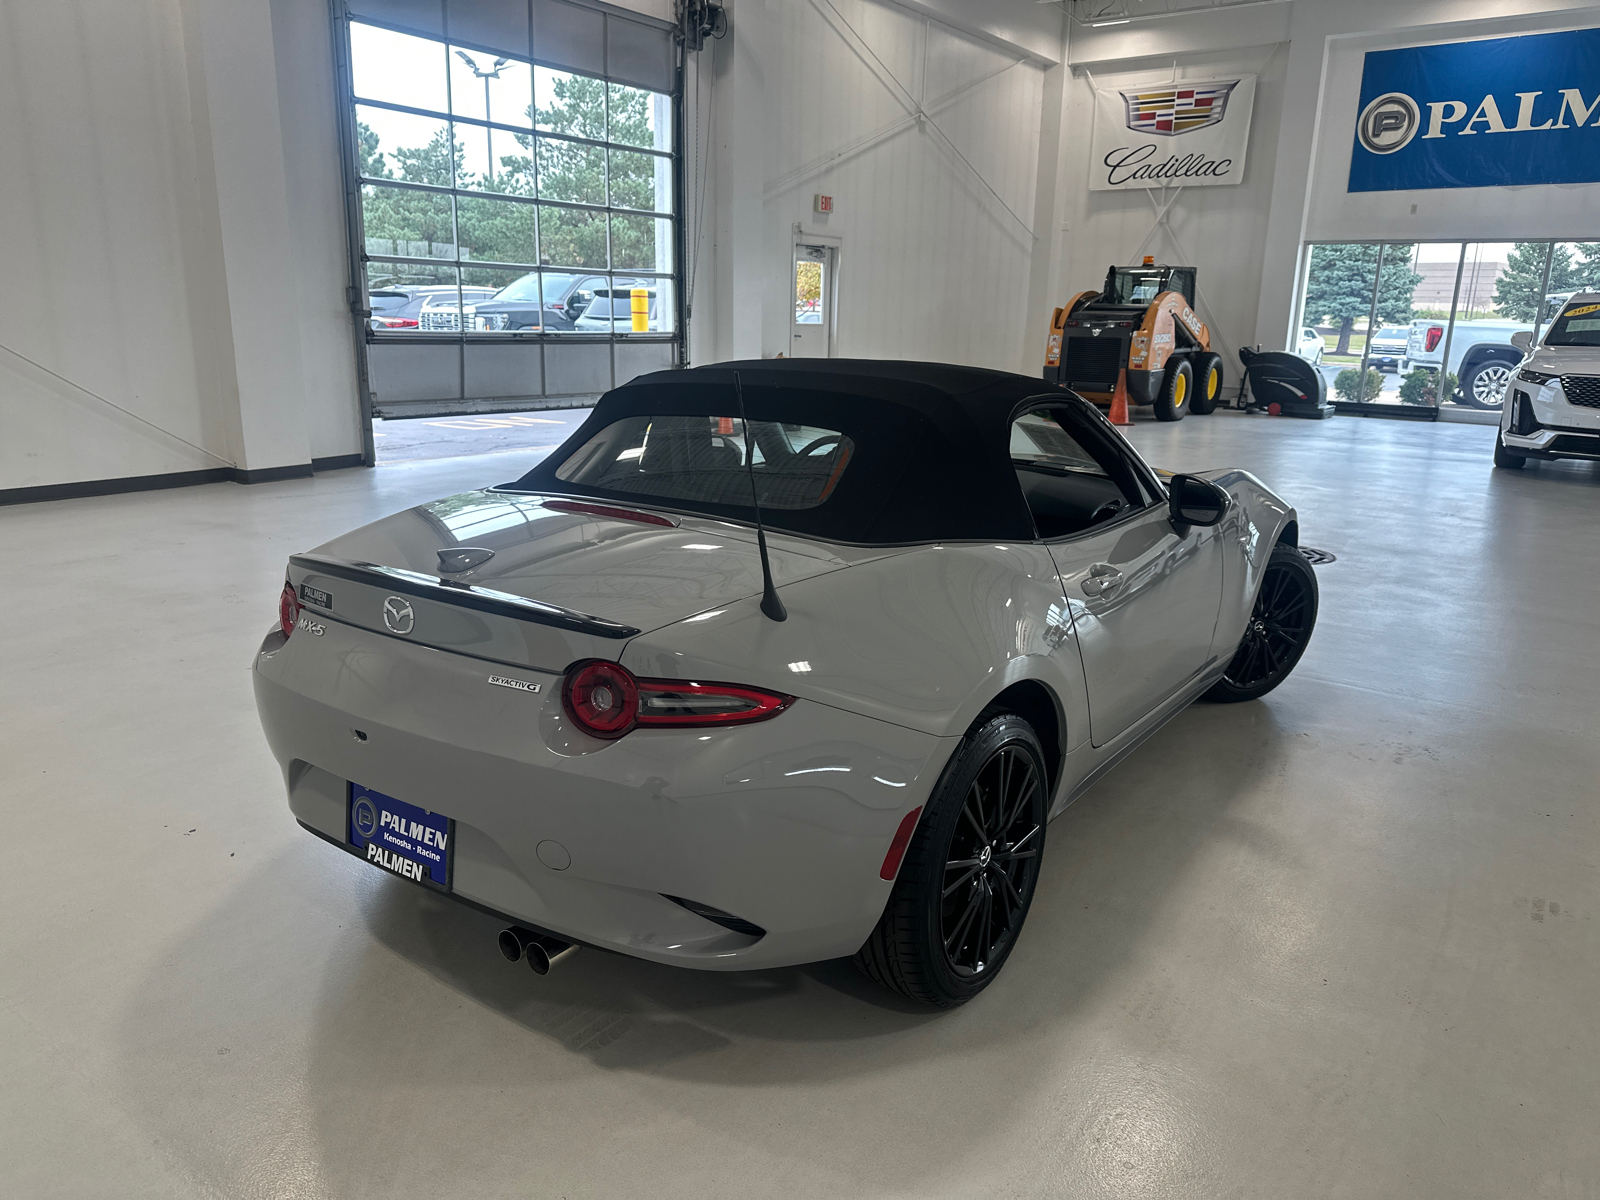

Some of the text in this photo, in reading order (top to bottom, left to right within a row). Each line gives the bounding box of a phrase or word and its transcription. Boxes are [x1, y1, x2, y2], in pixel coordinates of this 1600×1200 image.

[1421, 88, 1600, 139] PALM
[1103, 144, 1232, 185] Cadillac
[821, 195, 832, 211] EXIT
[1182, 306, 1202, 335] CASE
[304, 586, 327, 603] PALMEN
[297, 617, 327, 636] MX-5
[380, 810, 447, 851] PALMEN
[384, 832, 411, 850] Kenosha
[417, 845, 440, 862] Racine
[367, 843, 423, 882] PALMEN
